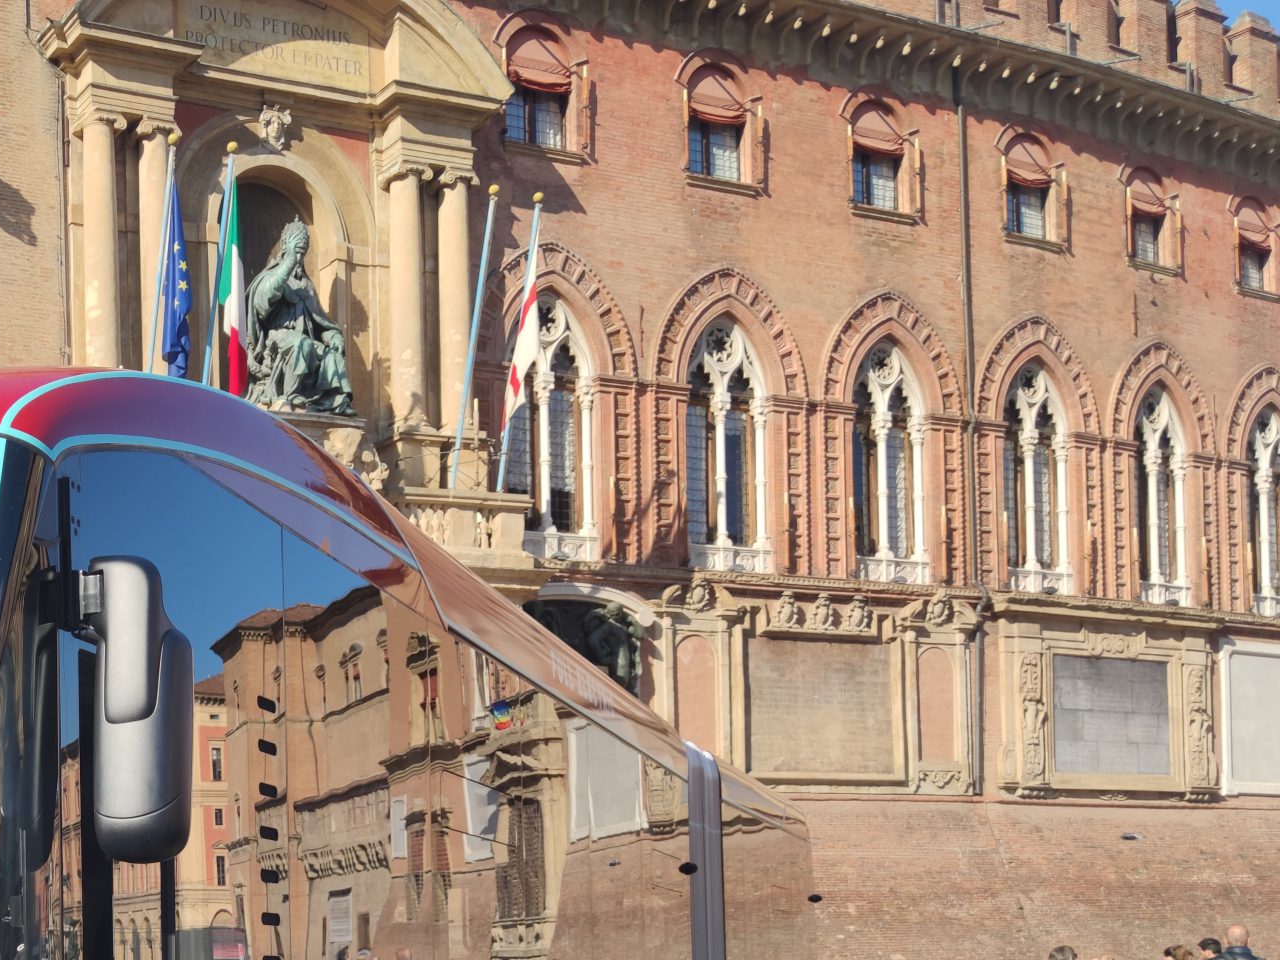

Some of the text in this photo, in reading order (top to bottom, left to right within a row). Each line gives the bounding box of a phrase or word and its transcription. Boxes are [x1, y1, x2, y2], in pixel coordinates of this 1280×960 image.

[261, 16, 351, 46] PETRONIUS
[185, 30, 289, 63] PROTECTOR
[314, 52, 363, 77] PATER
